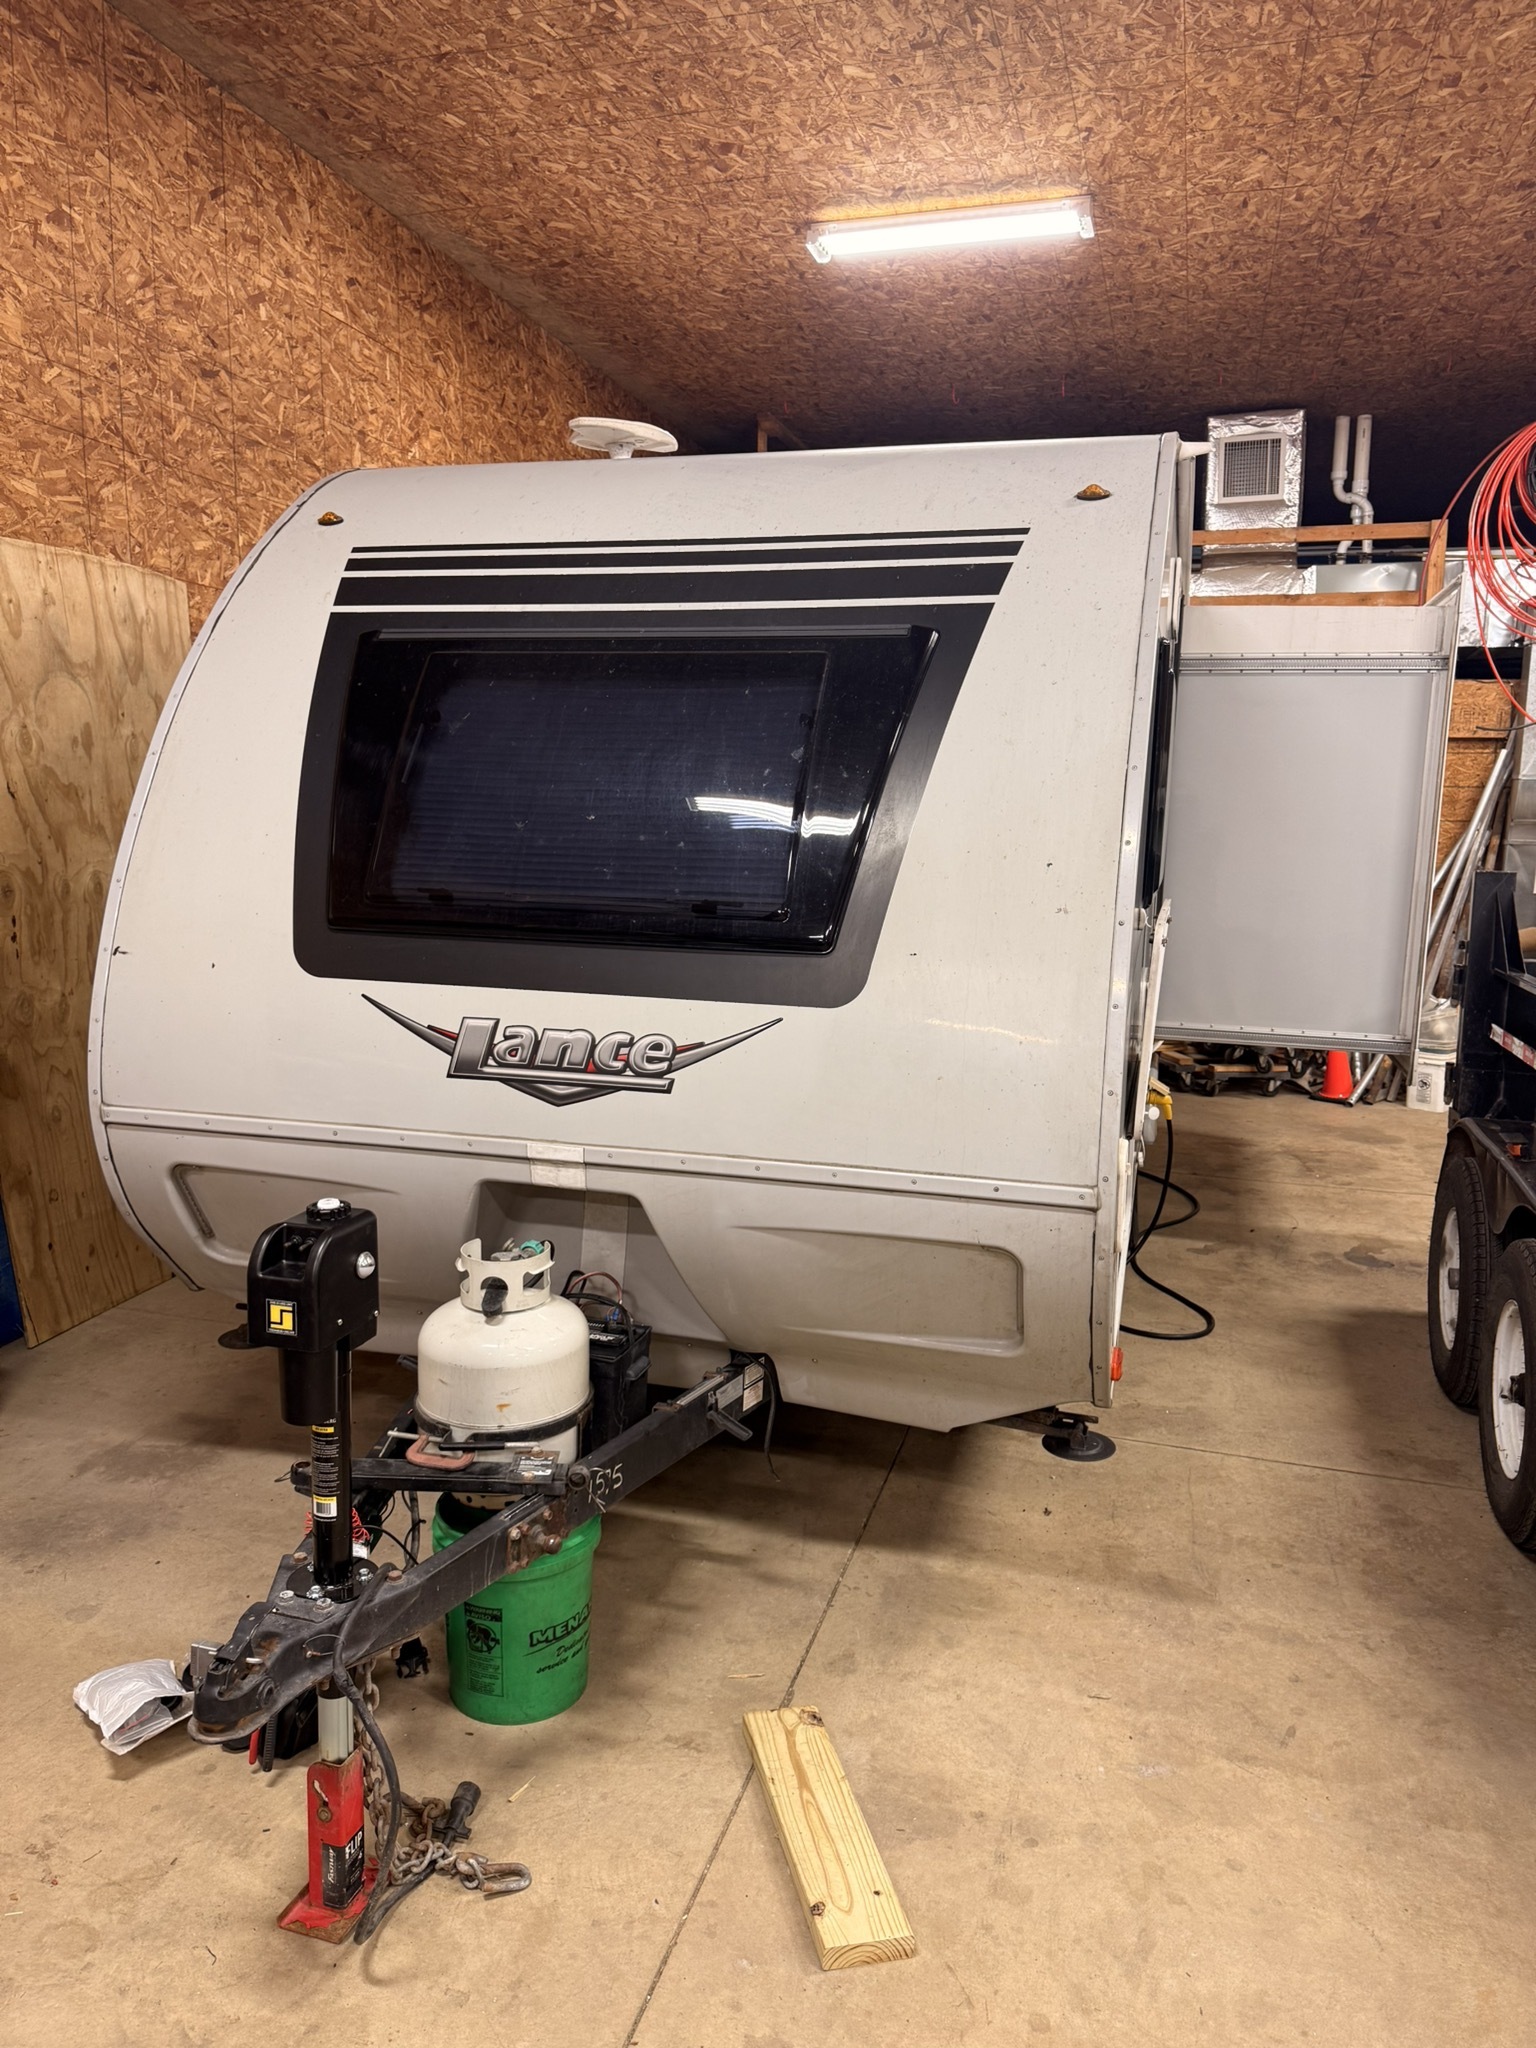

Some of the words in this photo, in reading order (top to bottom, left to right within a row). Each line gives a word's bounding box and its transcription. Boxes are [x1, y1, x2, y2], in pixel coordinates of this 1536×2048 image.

[446, 1016, 676, 1094] Lance
[529, 1602, 592, 1648] MENA
[345, 1831, 363, 1860] FLIP
